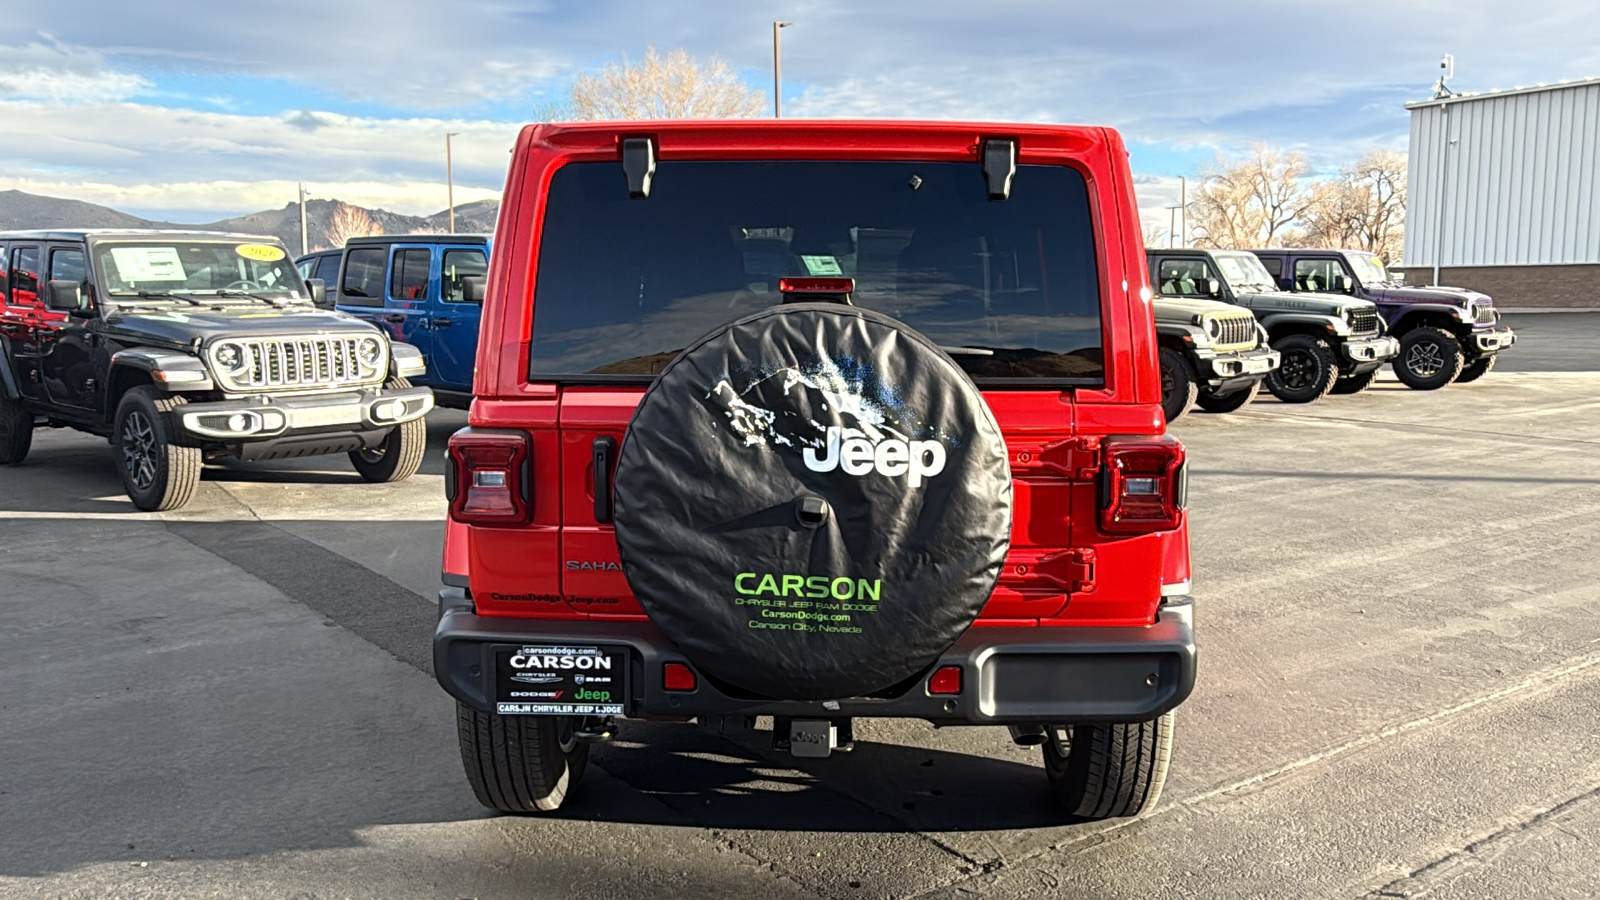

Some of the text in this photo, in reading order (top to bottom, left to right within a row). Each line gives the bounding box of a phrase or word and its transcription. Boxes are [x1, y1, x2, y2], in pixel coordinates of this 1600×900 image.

[802, 426, 947, 488] Jeep
[566, 560, 623, 570] SAHA
[734, 572, 881, 600] CARSON
[735, 598, 786, 607] CHRYSLER
[762, 609, 850, 622] CarsonDodge.com
[748, 620, 862, 633] Carson City, Nevada
[524, 647, 596, 655] carsondodge.com
[510, 656, 611, 669] CARSON
[574, 687, 610, 702] Jeep
[532, 705, 573, 713] CHRYSLER
[574, 705, 593, 713] JEEP
[795, 731, 826, 744] Jeep
